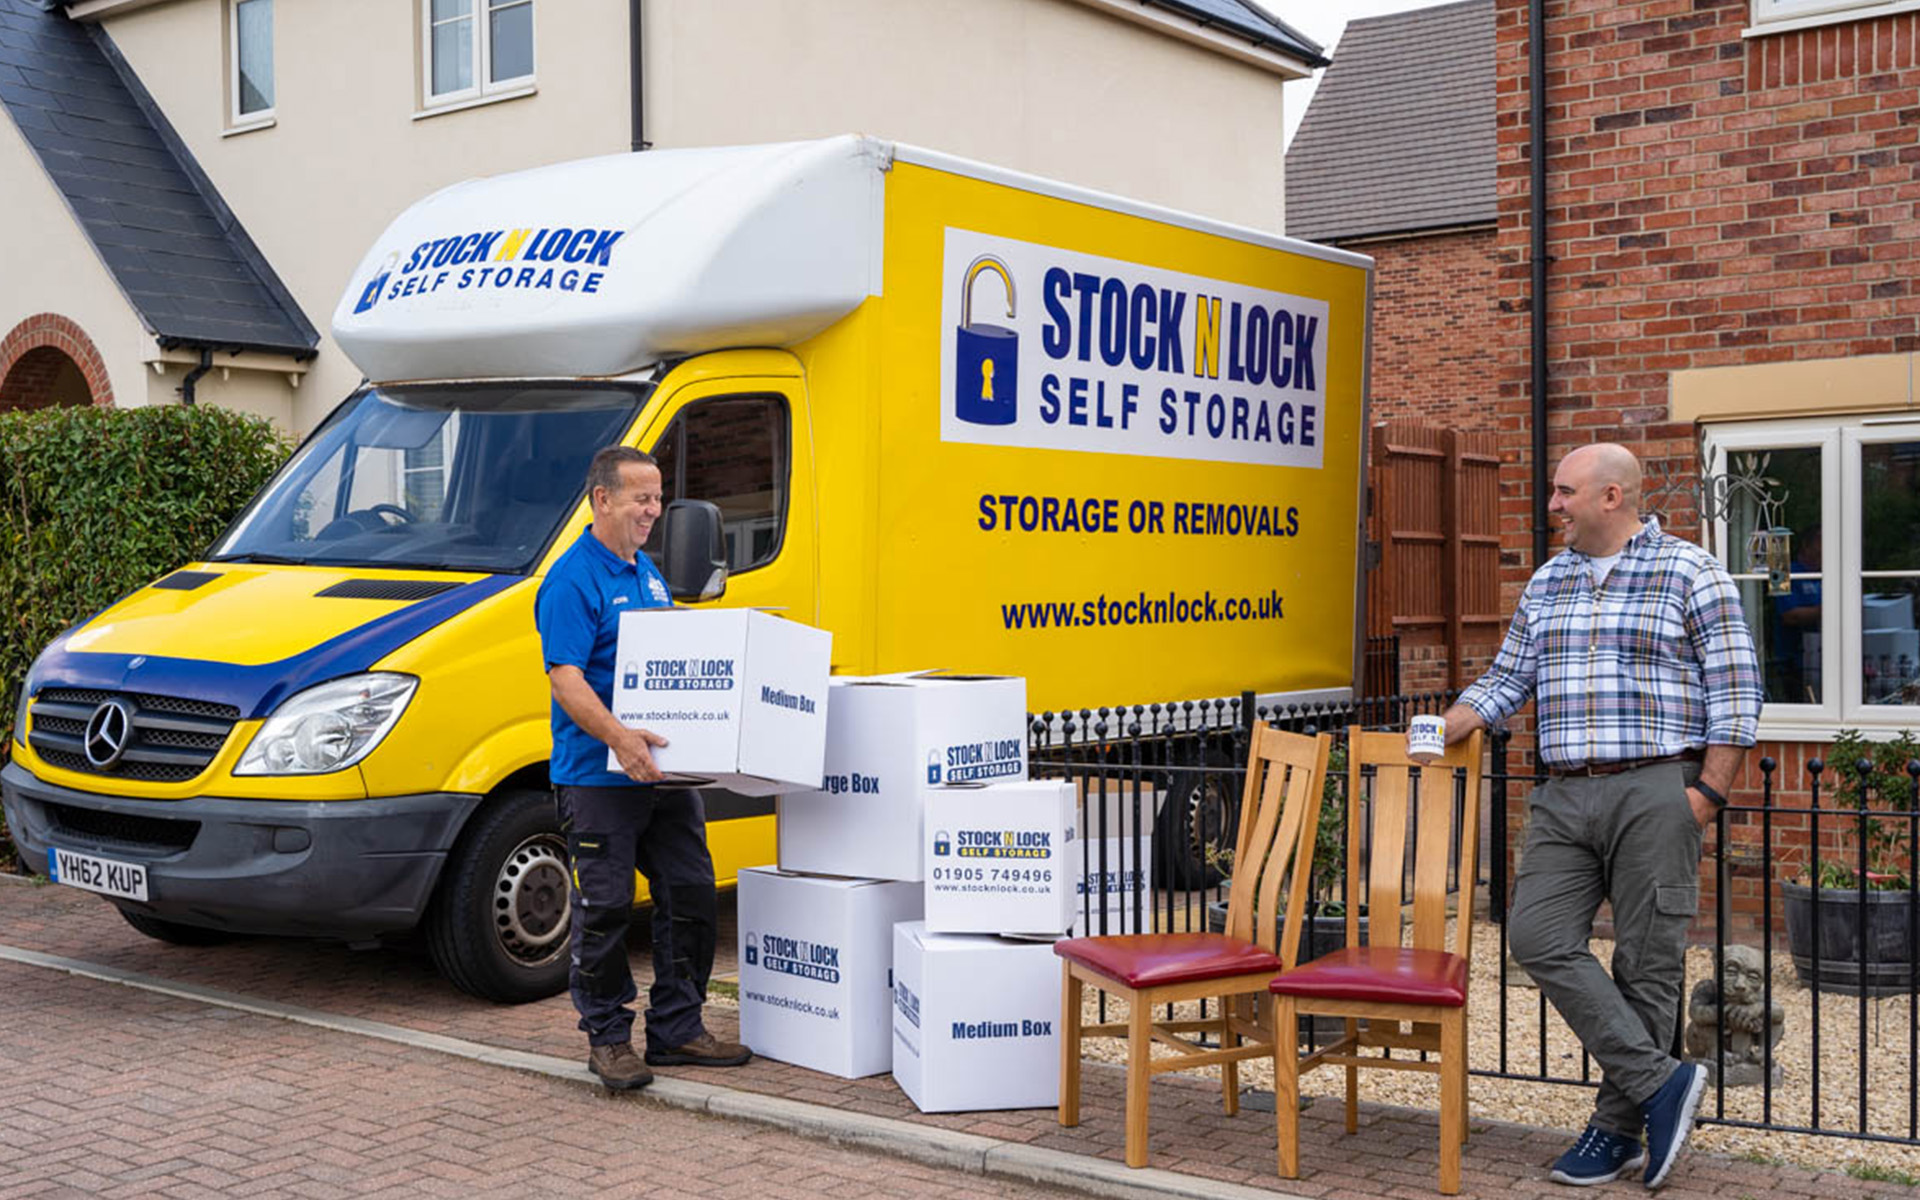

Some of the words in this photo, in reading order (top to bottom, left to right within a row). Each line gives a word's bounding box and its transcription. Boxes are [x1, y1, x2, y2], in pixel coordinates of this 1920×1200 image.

[402, 230, 504, 275] STOCK
[493, 228, 532, 262] N
[523, 228, 625, 267] LOCK
[388, 271, 449, 300] SELF
[457, 267, 604, 294] STORAGE
[1042, 266, 1187, 375] STOCK
[1194, 293, 1222, 380] N
[1228, 301, 1319, 391] LOCK
[1039, 373, 1139, 429] SELF
[1158, 388, 1316, 447] STORAGE
[978, 494, 1119, 533] STORAGE
[1128, 500, 1165, 534] OR
[1173, 502, 1299, 537] REMOVALS
[1002, 589, 1284, 630] www.stocknlock.co.uk
[645, 659, 687, 677] STOCK
[688, 658, 700, 677] N
[701, 659, 734, 676] LOCK
[647, 680, 674, 690] SELF
[678, 680, 731, 690] STORAGE
[761, 684, 799, 711] Medium
[799, 694, 816, 715] Box
[620, 709, 730, 721] www.stocknlock.co.uk
[1411, 723, 1437, 735] STOCK
[946, 743, 983, 767] STOCK
[995, 738, 1021, 761] LOCK
[822, 774, 849, 795] rge
[851, 772, 880, 794] Box
[950, 767, 976, 781] SELF
[977, 762, 1020, 778] STORAGE
[957, 830, 1002, 846] STOCK
[1003, 831, 1014, 847] N
[1016, 832, 1051, 847] LOCK
[961, 848, 989, 856] SELF
[994, 848, 1047, 858] STORAGE
[58, 853, 103, 887] YH62
[106, 863, 143, 894] KUP
[933, 867, 983, 880] 01905
[990, 869, 1052, 882] 749496
[934, 883, 1051, 893] www.stocknlock.co.uk
[763, 934, 798, 960] STOCK
[810, 943, 839, 967] LOCK
[765, 957, 789, 972] SELF
[792, 961, 837, 983] STORAGE
[745, 990, 840, 1019] www.stocknlock.co.uk
[952, 1022, 1018, 1039] Medium
[1022, 1020, 1052, 1036] Box
